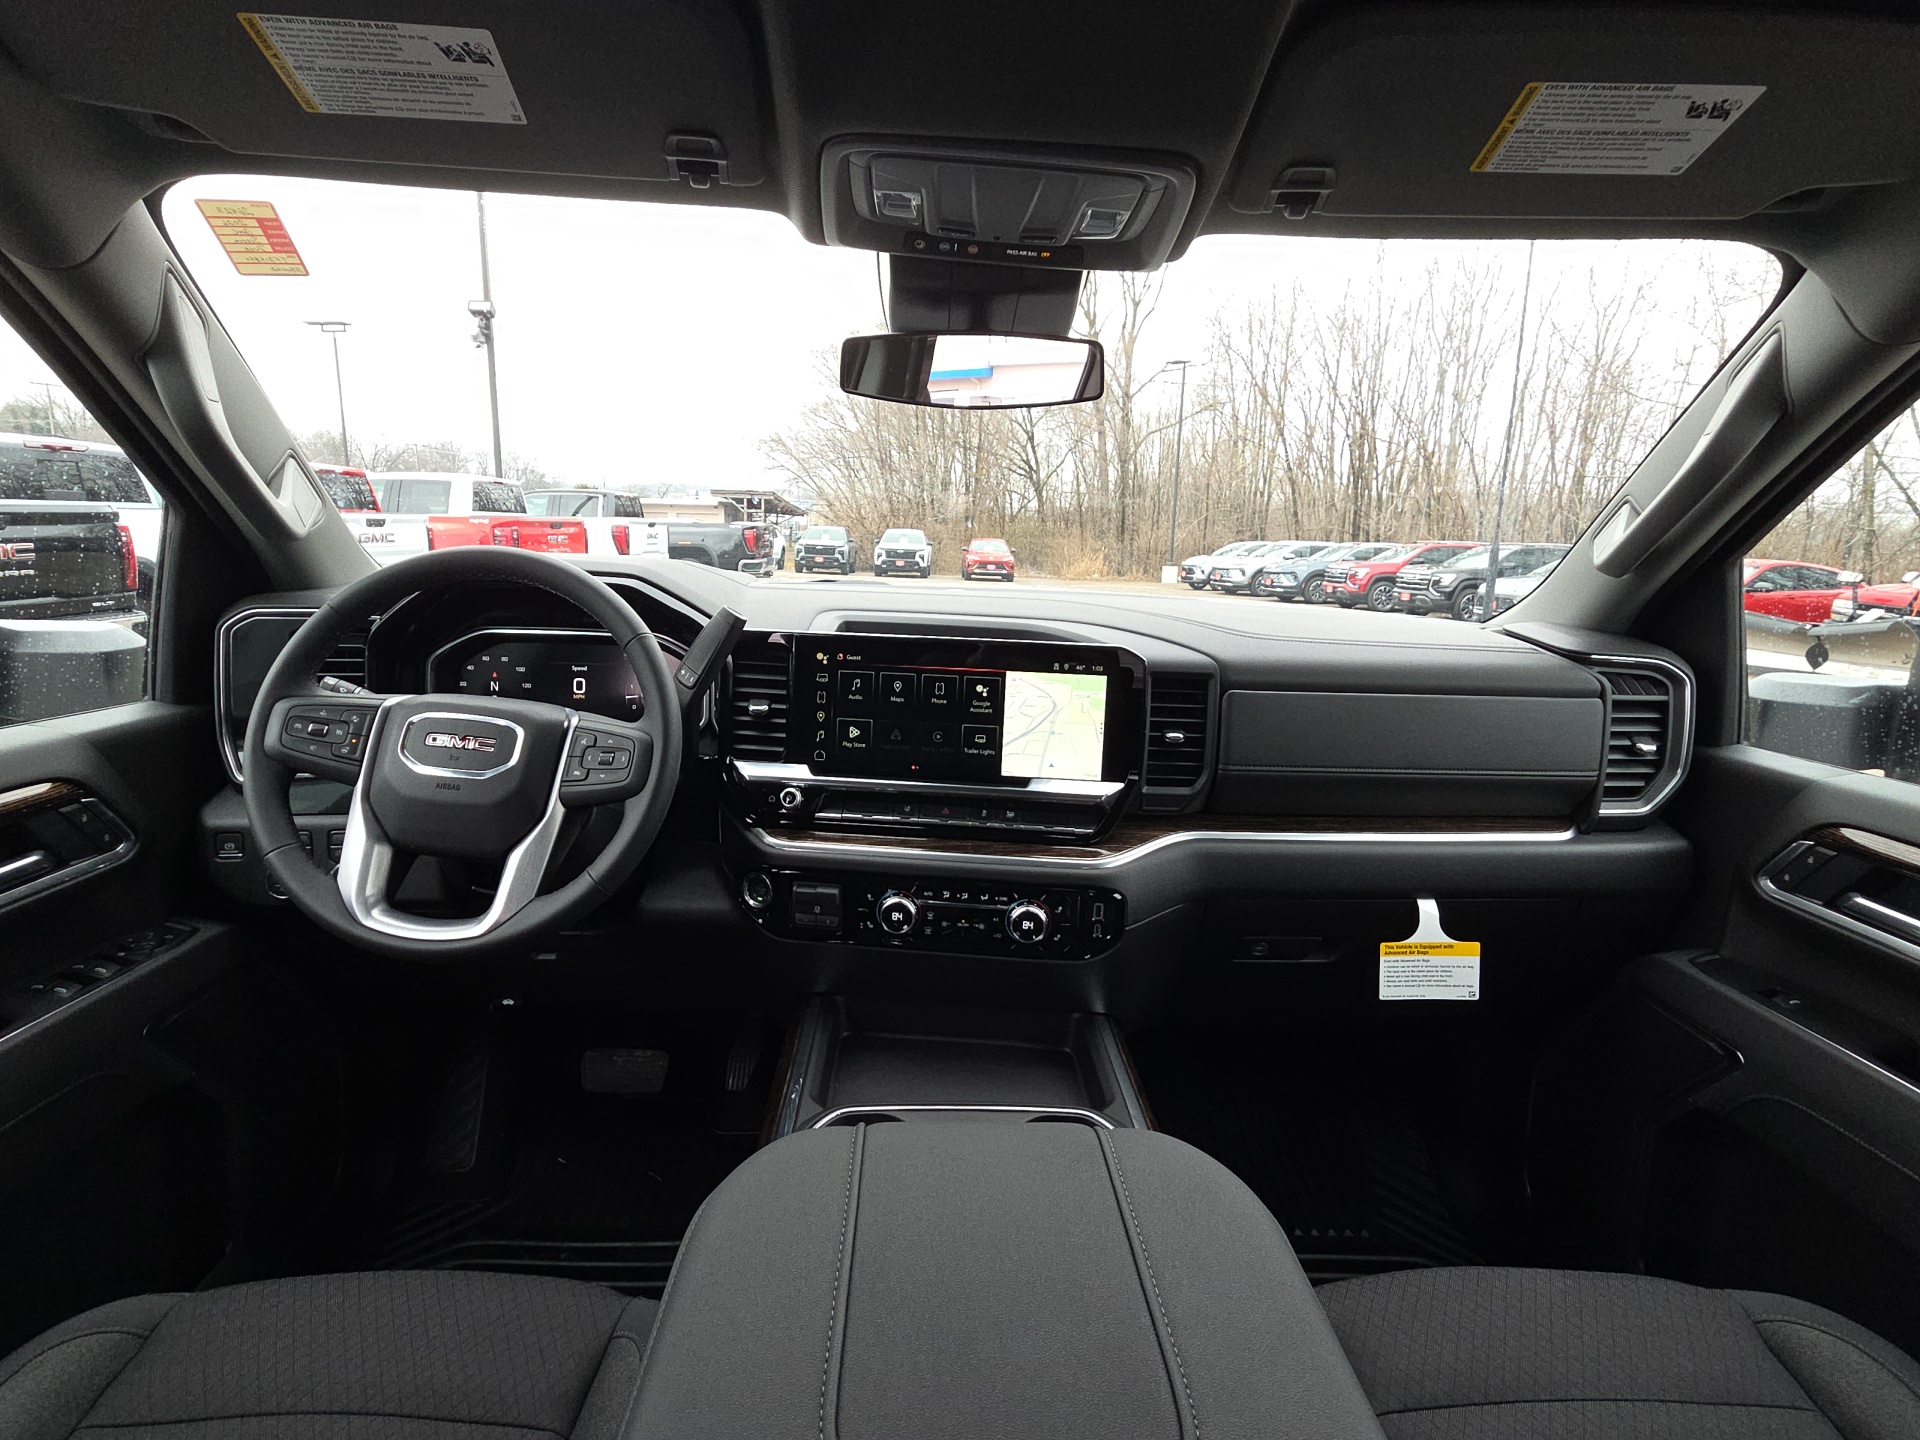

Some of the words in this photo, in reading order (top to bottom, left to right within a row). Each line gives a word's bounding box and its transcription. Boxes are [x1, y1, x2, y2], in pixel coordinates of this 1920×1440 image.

[308, 19, 356, 28] ADVANCED
[358, 21, 373, 29] AIR
[374, 22, 398, 30] BAGS
[359, 533, 396, 543] GMC
[490, 681, 499, 692] N
[572, 677, 586, 694] 0
[424, 732, 497, 752] GMC
[435, 782, 461, 791] AIRBAG
[891, 912, 903, 921] 84
[1022, 921, 1034, 930] 84
